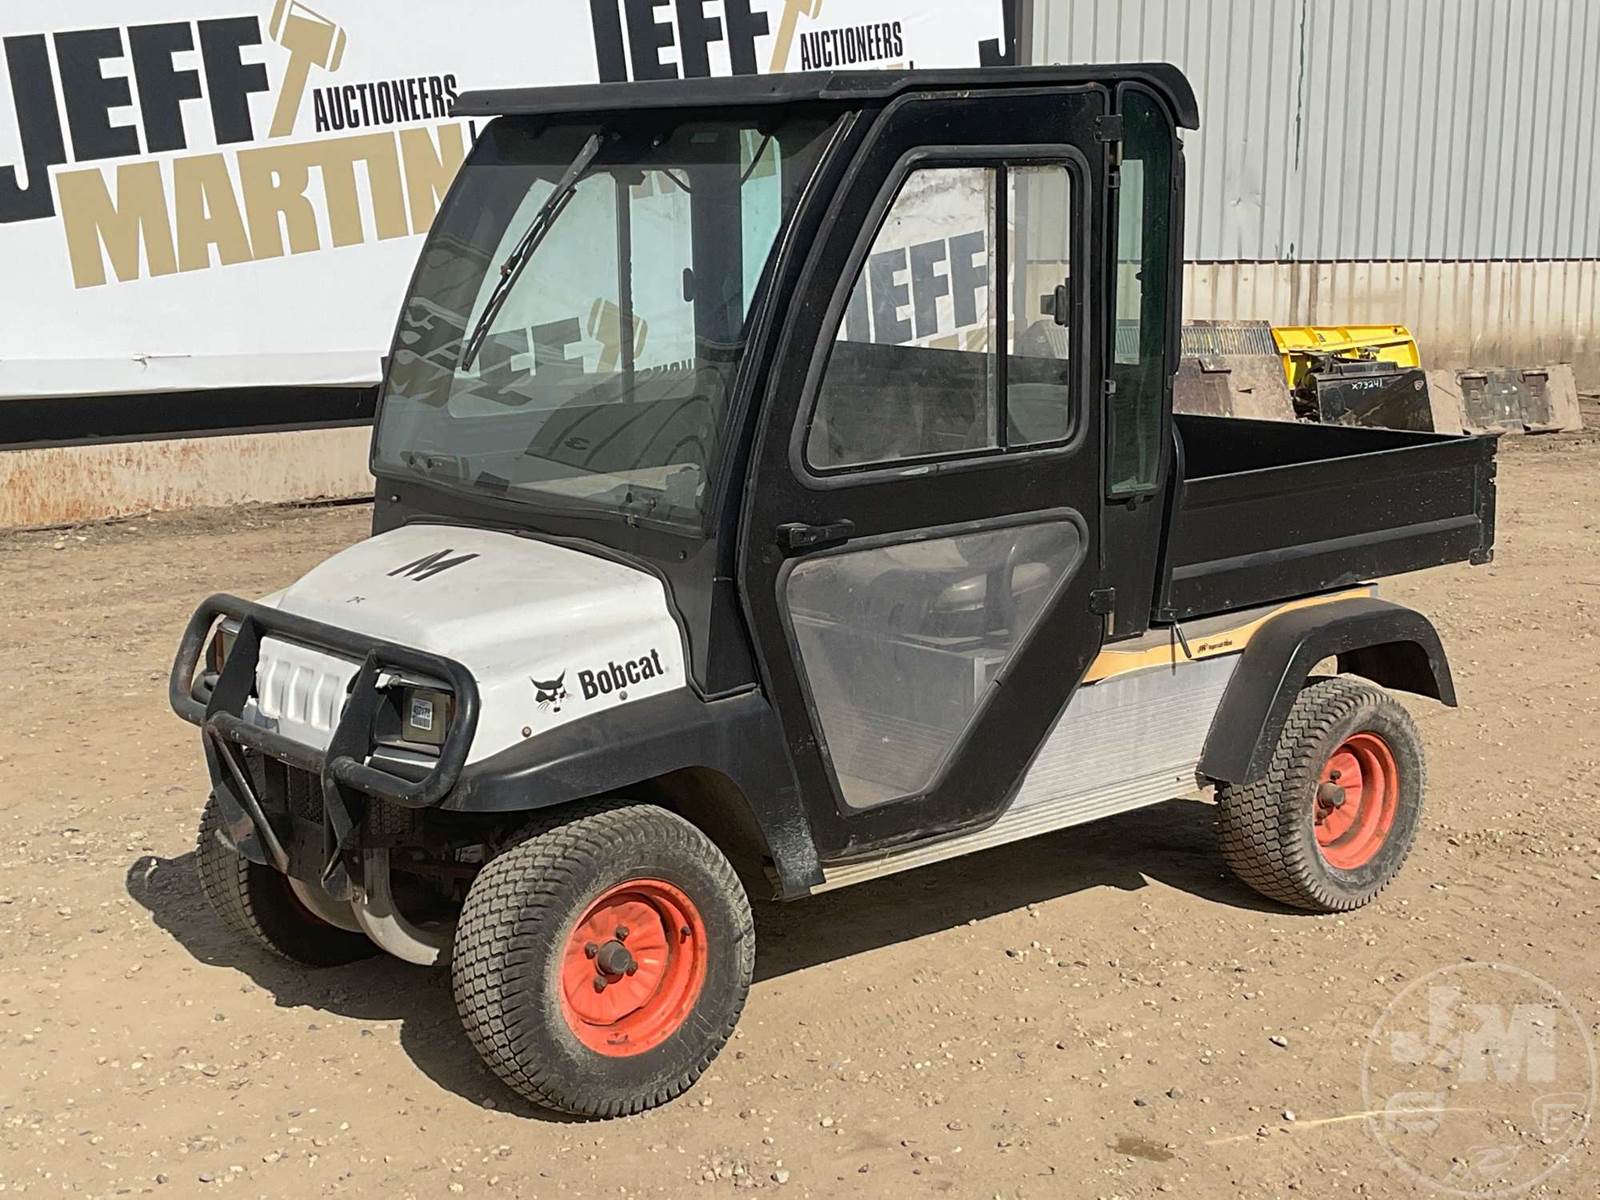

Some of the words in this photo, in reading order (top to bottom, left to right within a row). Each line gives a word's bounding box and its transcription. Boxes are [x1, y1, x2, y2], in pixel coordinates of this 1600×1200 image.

[800, 21, 903, 71] AUCTIONEERS
[0, 15, 270, 224] JEFF
[313, 74, 458, 132] AUCTIONEERS
[56, 123, 468, 289] MARTIN
[578, 648, 664, 700] Bobcat
